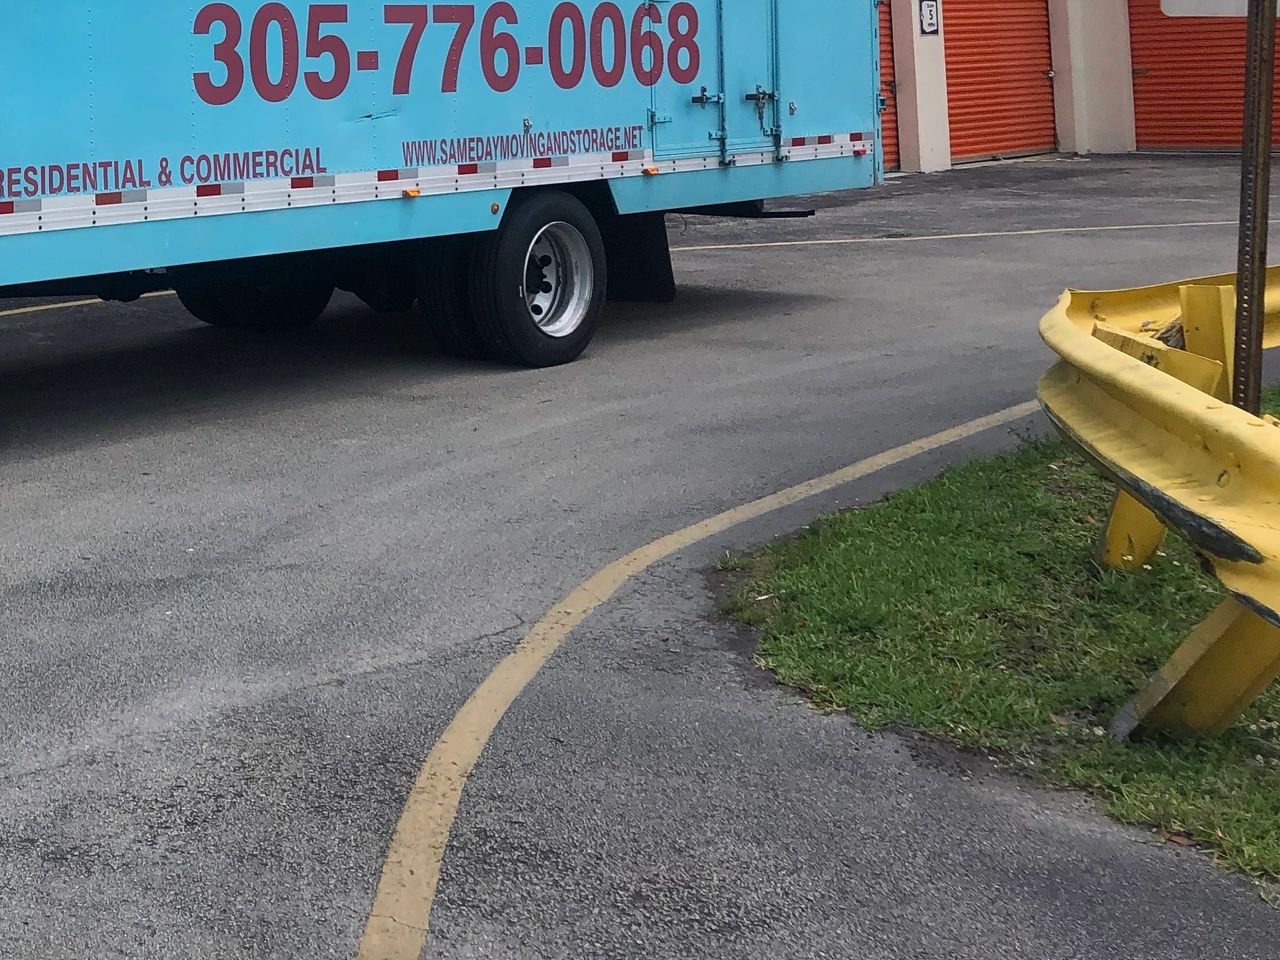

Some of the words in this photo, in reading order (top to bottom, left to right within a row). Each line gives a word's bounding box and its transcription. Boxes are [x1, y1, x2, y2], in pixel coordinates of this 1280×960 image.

[193, 1, 701, 106] 305-776-0068
[402, 125, 644, 166] WWW.SAMEDAYMOVINGANDSTORAGE.NET
[157, 156, 173, 187] &
[179, 146, 328, 185] COMMERCIAL
